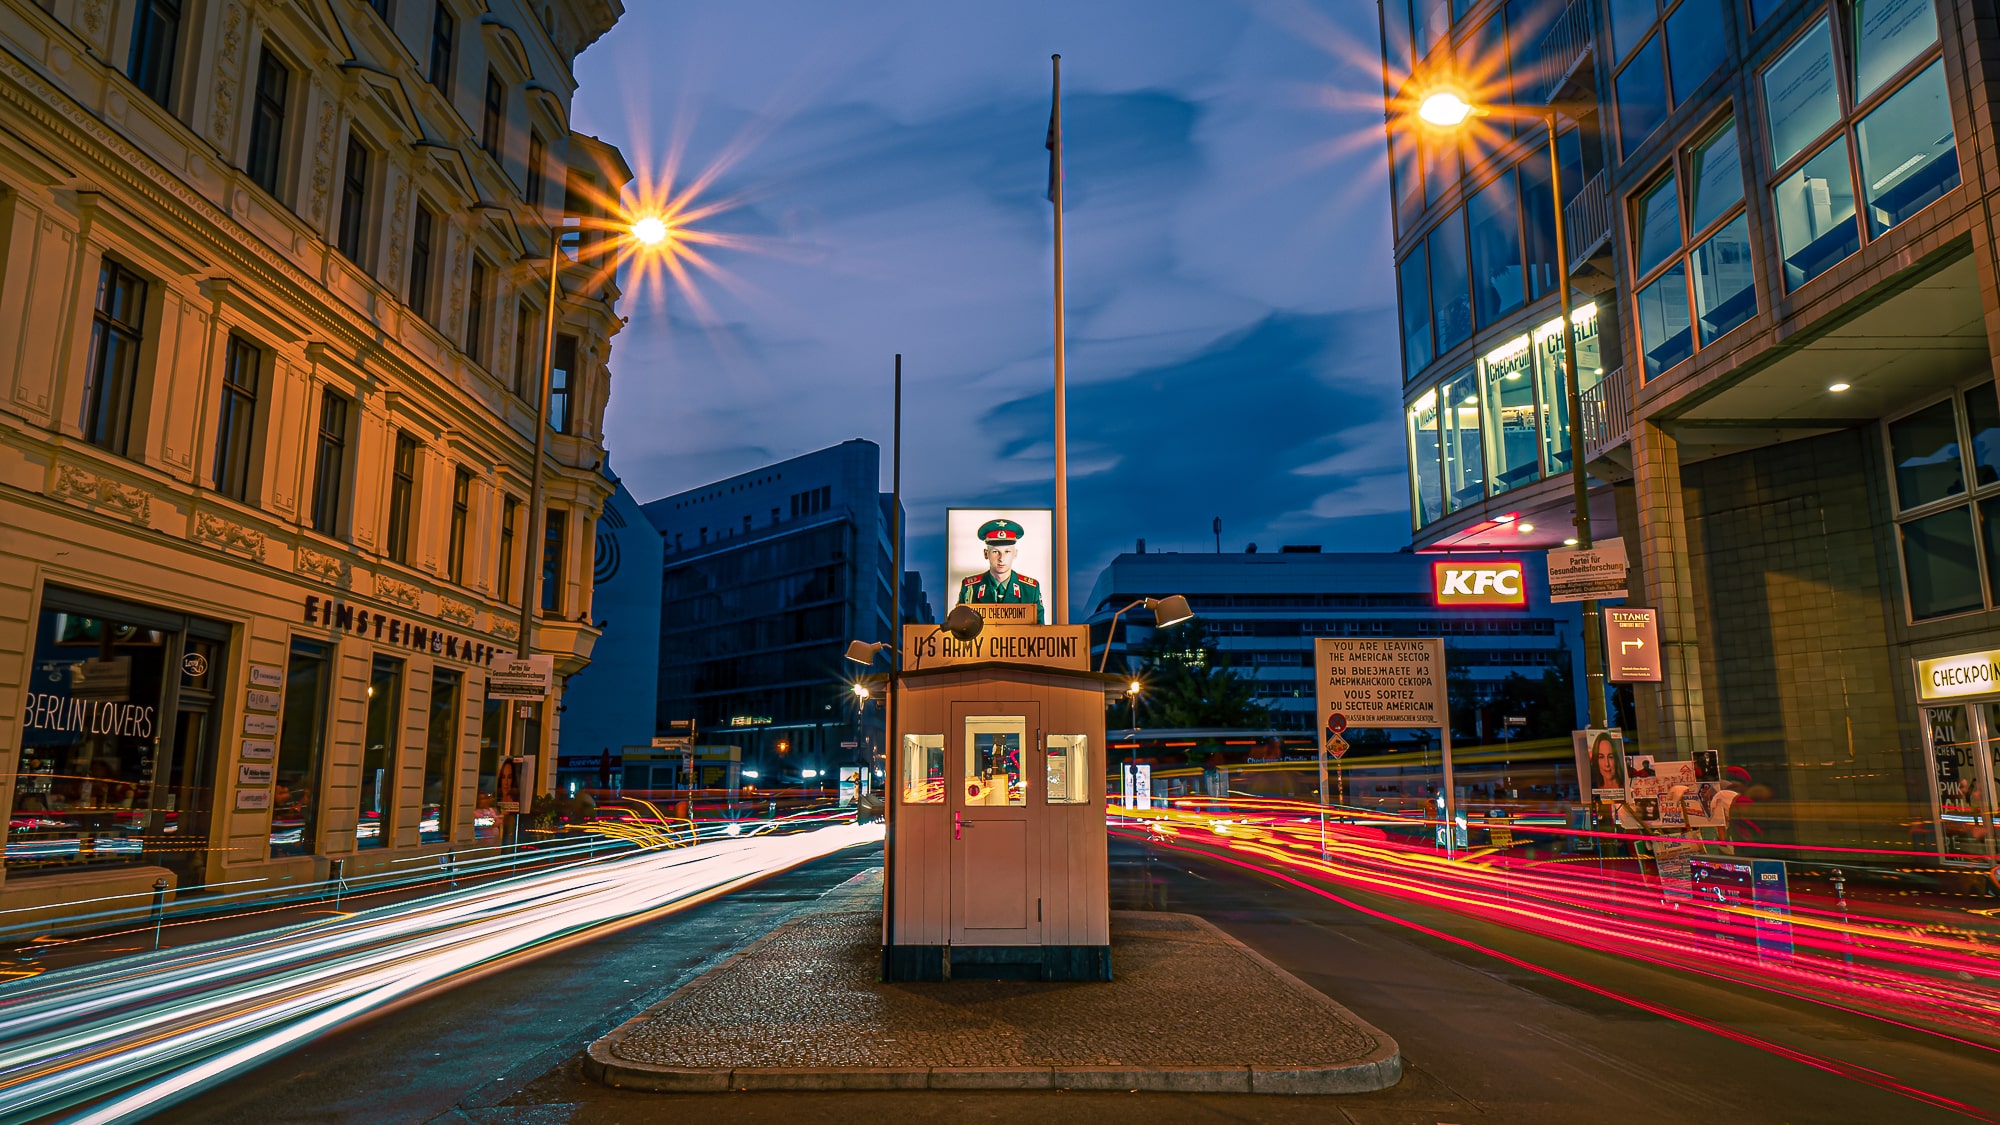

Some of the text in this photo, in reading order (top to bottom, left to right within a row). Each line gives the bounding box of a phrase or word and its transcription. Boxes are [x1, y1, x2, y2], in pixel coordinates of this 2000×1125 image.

[1569, 556, 1590, 566] Partei
[1549, 562, 1624, 576] Gesundheitsforschung
[1441, 569, 1520, 595] KFC
[988, 607, 1026, 619] CHECKPOINT
[1613, 612, 1650, 621] TITANIC
[304, 595, 513, 666] EINSTEIN KAFF
[942, 637, 984, 658] ARMY
[990, 636, 1078, 658] CHECKPOINT
[1333, 641, 1424, 651] YOU ARE LEAVING
[1329, 652, 1430, 662] THE AMERICAN SECTOR
[1331, 666, 1429, 676] ВЫ ВЫЕЗЖАЕТЕ ИЗ
[1329, 677, 1433, 687] АМЕРИКАНСКОГО СЕКТОРА
[1344, 690, 1415, 700] VOUS SORTEZ
[1331, 701, 1342, 711] DU
[1345, 701, 1383, 711] SECTEUR
[23, 692, 154, 738] BERLIN LOVERS
